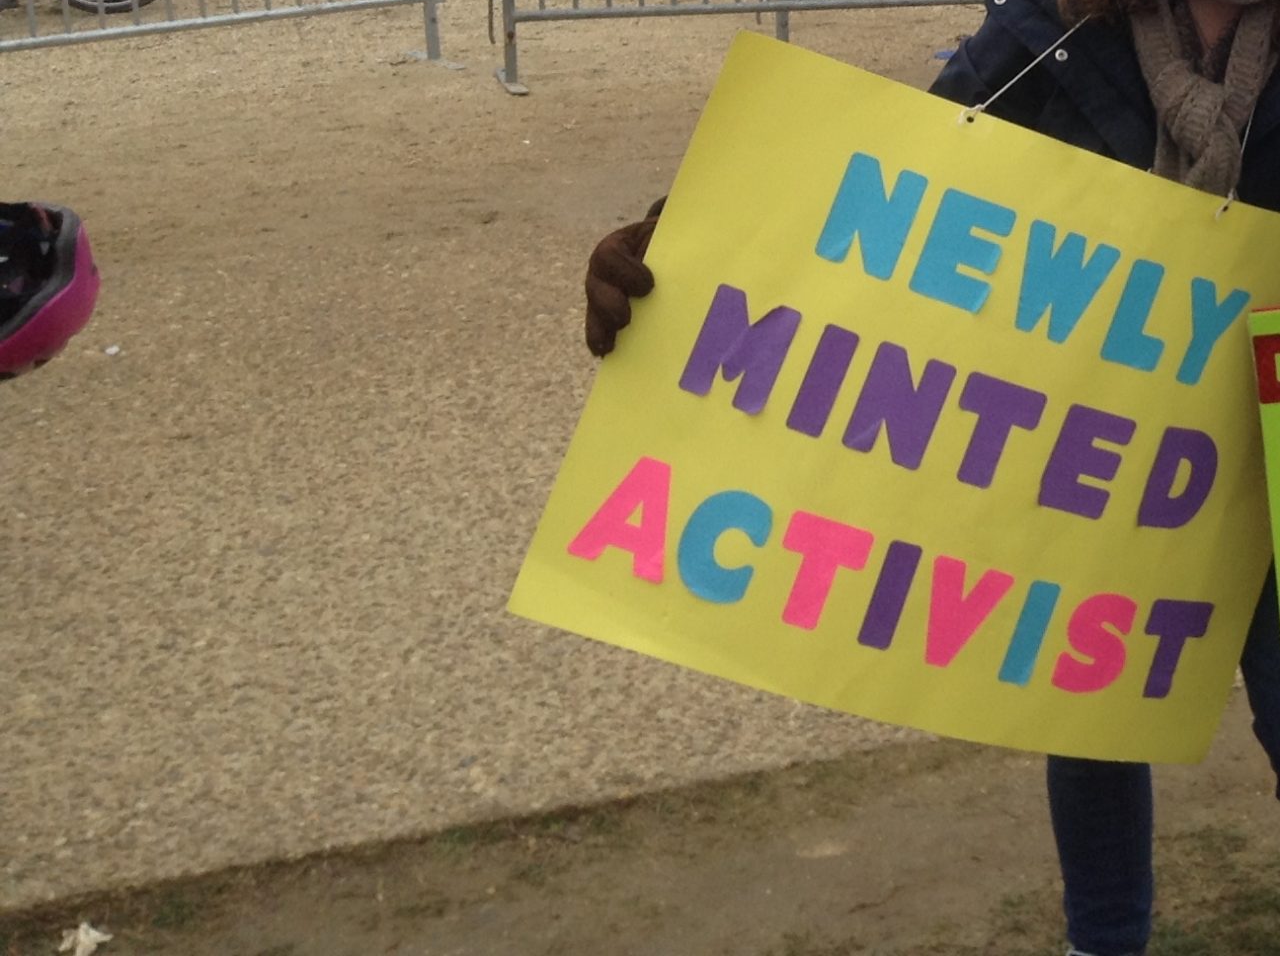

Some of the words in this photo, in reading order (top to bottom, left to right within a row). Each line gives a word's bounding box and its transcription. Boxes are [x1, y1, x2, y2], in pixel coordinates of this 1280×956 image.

[815, 151, 1251, 386] NEWLY
[678, 283, 1218, 528] MINTED
[566, 456, 1214, 699] ACTIVIST
